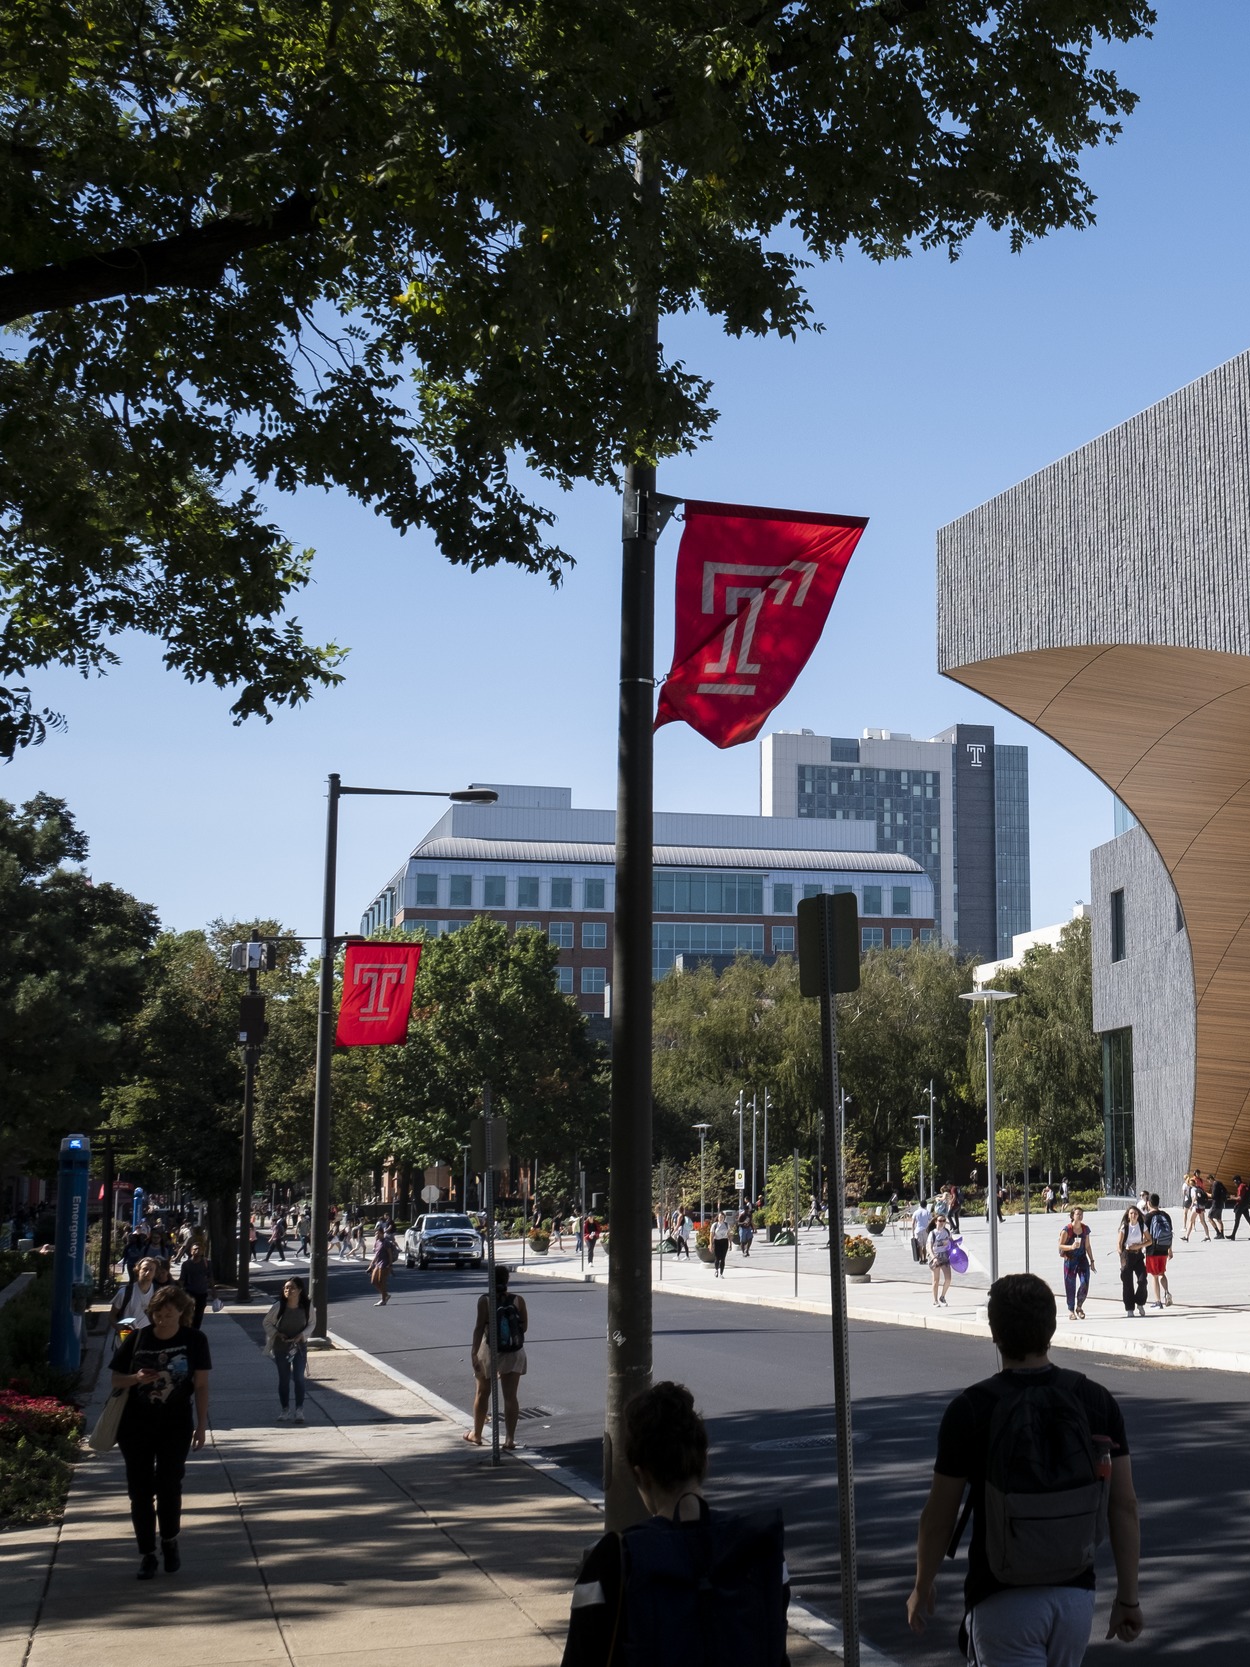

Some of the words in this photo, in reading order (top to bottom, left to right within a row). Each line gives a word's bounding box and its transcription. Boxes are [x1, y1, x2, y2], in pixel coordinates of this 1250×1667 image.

[966, 743, 986, 767] T
[353, 963, 408, 1022] T
[68, 1195, 82, 1259] Emergency
